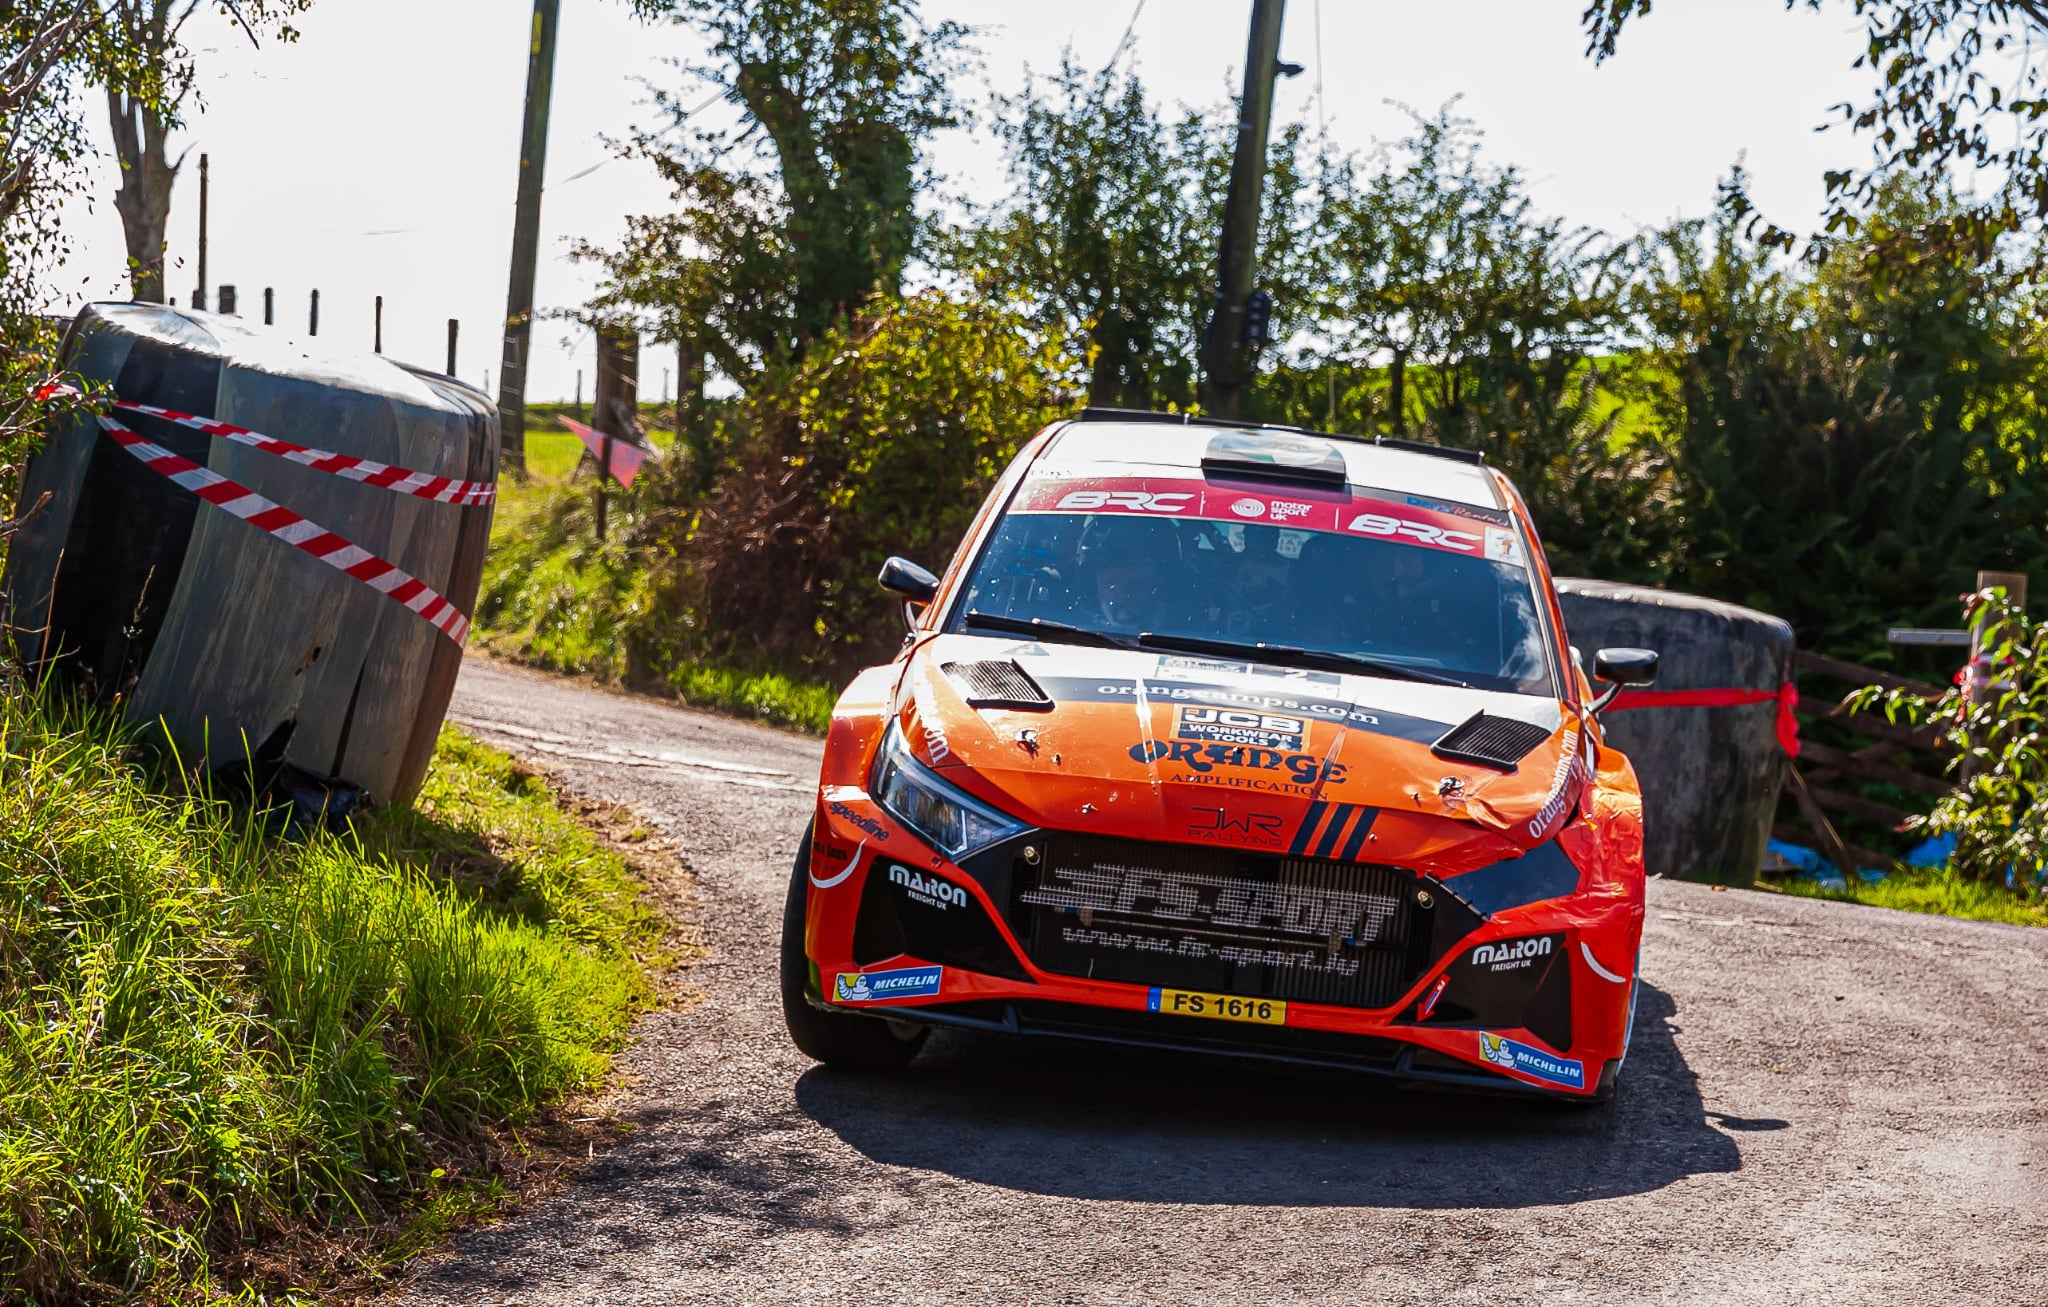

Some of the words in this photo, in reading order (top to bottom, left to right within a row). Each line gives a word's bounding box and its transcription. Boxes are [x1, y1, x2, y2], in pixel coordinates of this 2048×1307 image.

[1056, 491, 1196, 512] BRC
[1271, 501, 1312, 511] motor
[1271, 508, 1308, 517] sport
[1348, 514, 1483, 551] BRC
[1097, 683, 1380, 726] orangeamps.com
[1184, 708, 1301, 733] JCB
[1189, 724, 1292, 743] WORKWEAR
[1212, 733, 1268, 746] TOOLS
[1129, 740, 1348, 785] ORANGE
[1170, 773, 1329, 800] AMPLIFICATION
[829, 801, 890, 841] speedline
[1188, 806, 1283, 837] JWR
[1187, 829, 1282, 847] RALLYING
[908, 889, 936, 906] FREIGHT
[936, 900, 948, 911] UK
[1491, 961, 1520, 972] FREIGHT
[1521, 959, 1531, 968] UK
[873, 974, 939, 990] MICHELIN
[1173, 993, 1205, 1013] FS
[1214, 997, 1273, 1020] 1616
[1516, 1051, 1580, 1078] MICHELIN
